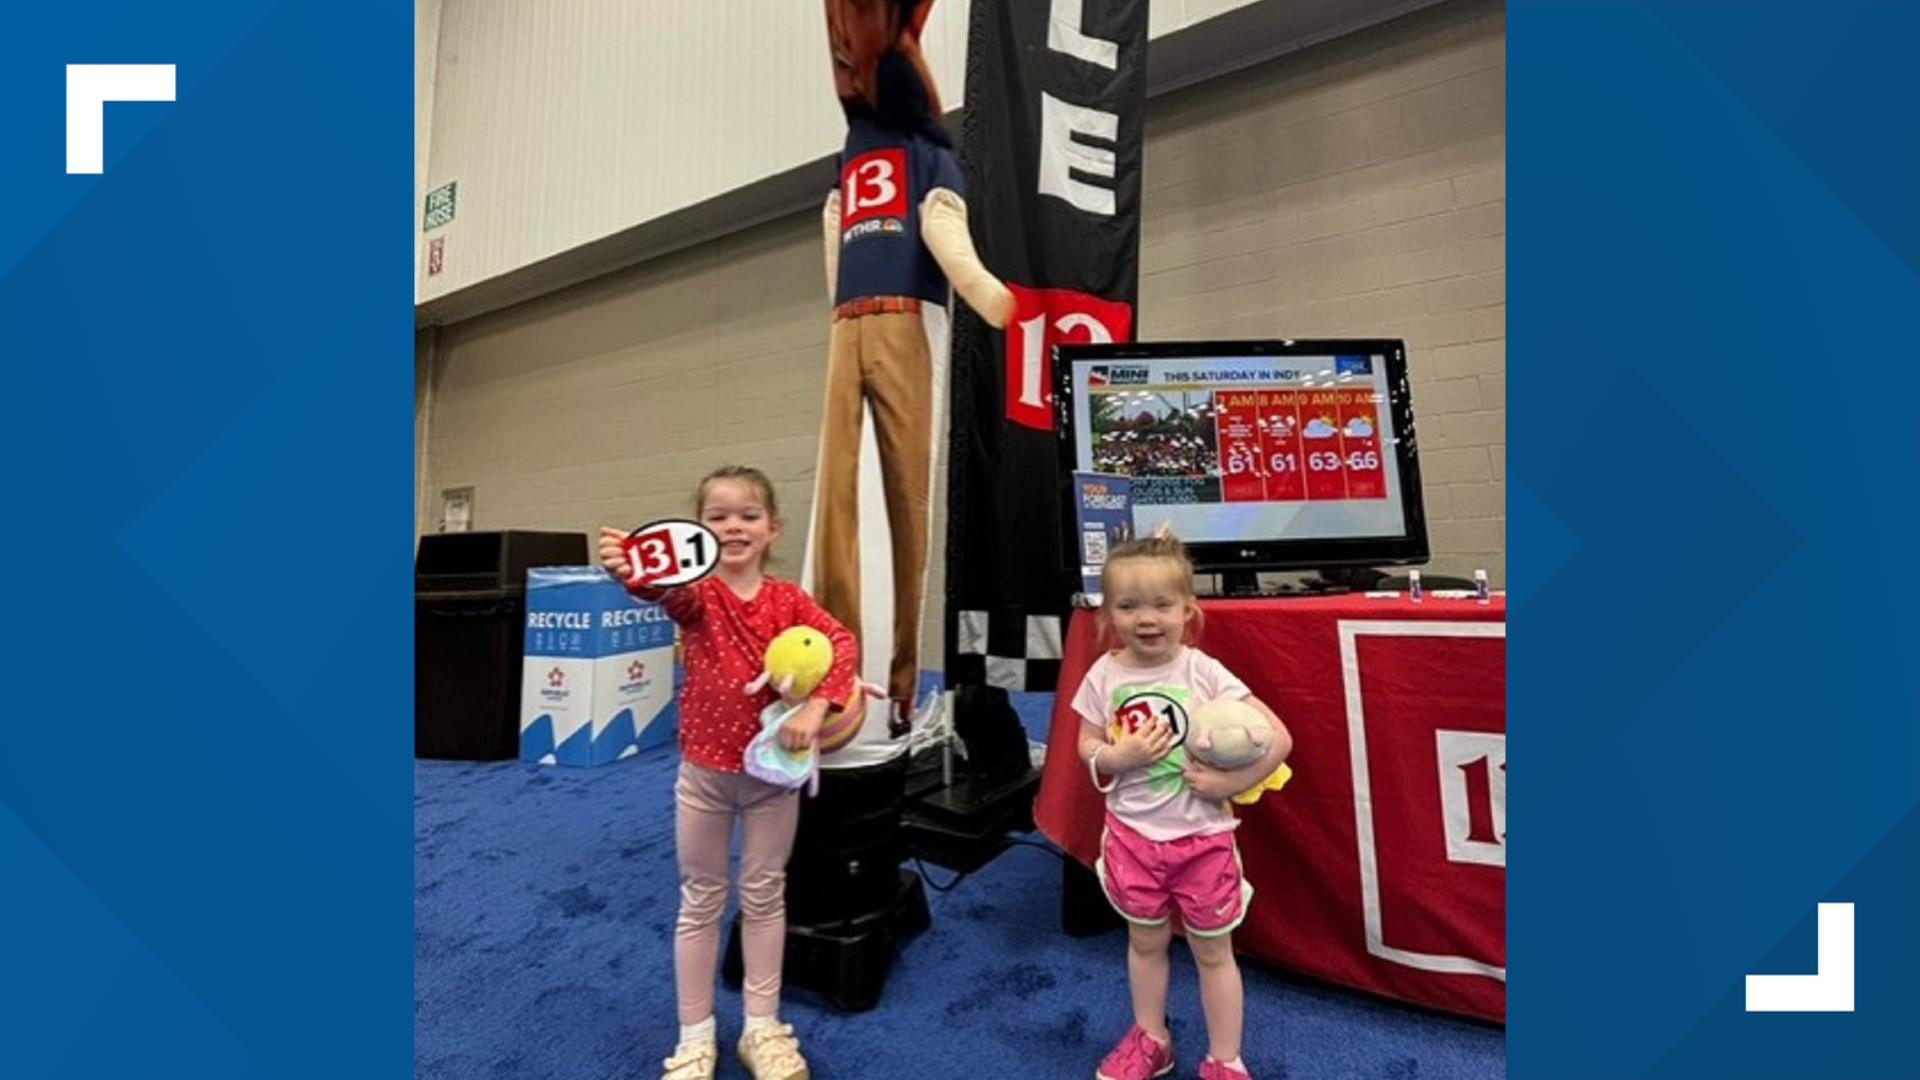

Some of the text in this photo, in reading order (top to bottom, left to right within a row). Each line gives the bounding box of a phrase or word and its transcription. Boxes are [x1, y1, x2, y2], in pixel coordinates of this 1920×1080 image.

[847, 159, 897, 218] 13
[1110, 369, 1149, 380] MINI
[1163, 369, 1301, 382] THIS SATURDAY IN INDY
[1229, 395, 1255, 406] AM
[1272, 394, 1296, 405] AM
[1312, 394, 1337, 405] AM
[1228, 453, 1254, 474] 61
[1271, 453, 1297, 472] 61
[1309, 452, 1338, 471] 63
[1350, 451, 1379, 471] 66
[627, 532, 706, 580] 13.1
[528, 611, 592, 630] RECYCLE
[1457, 754, 1506, 846] 1
